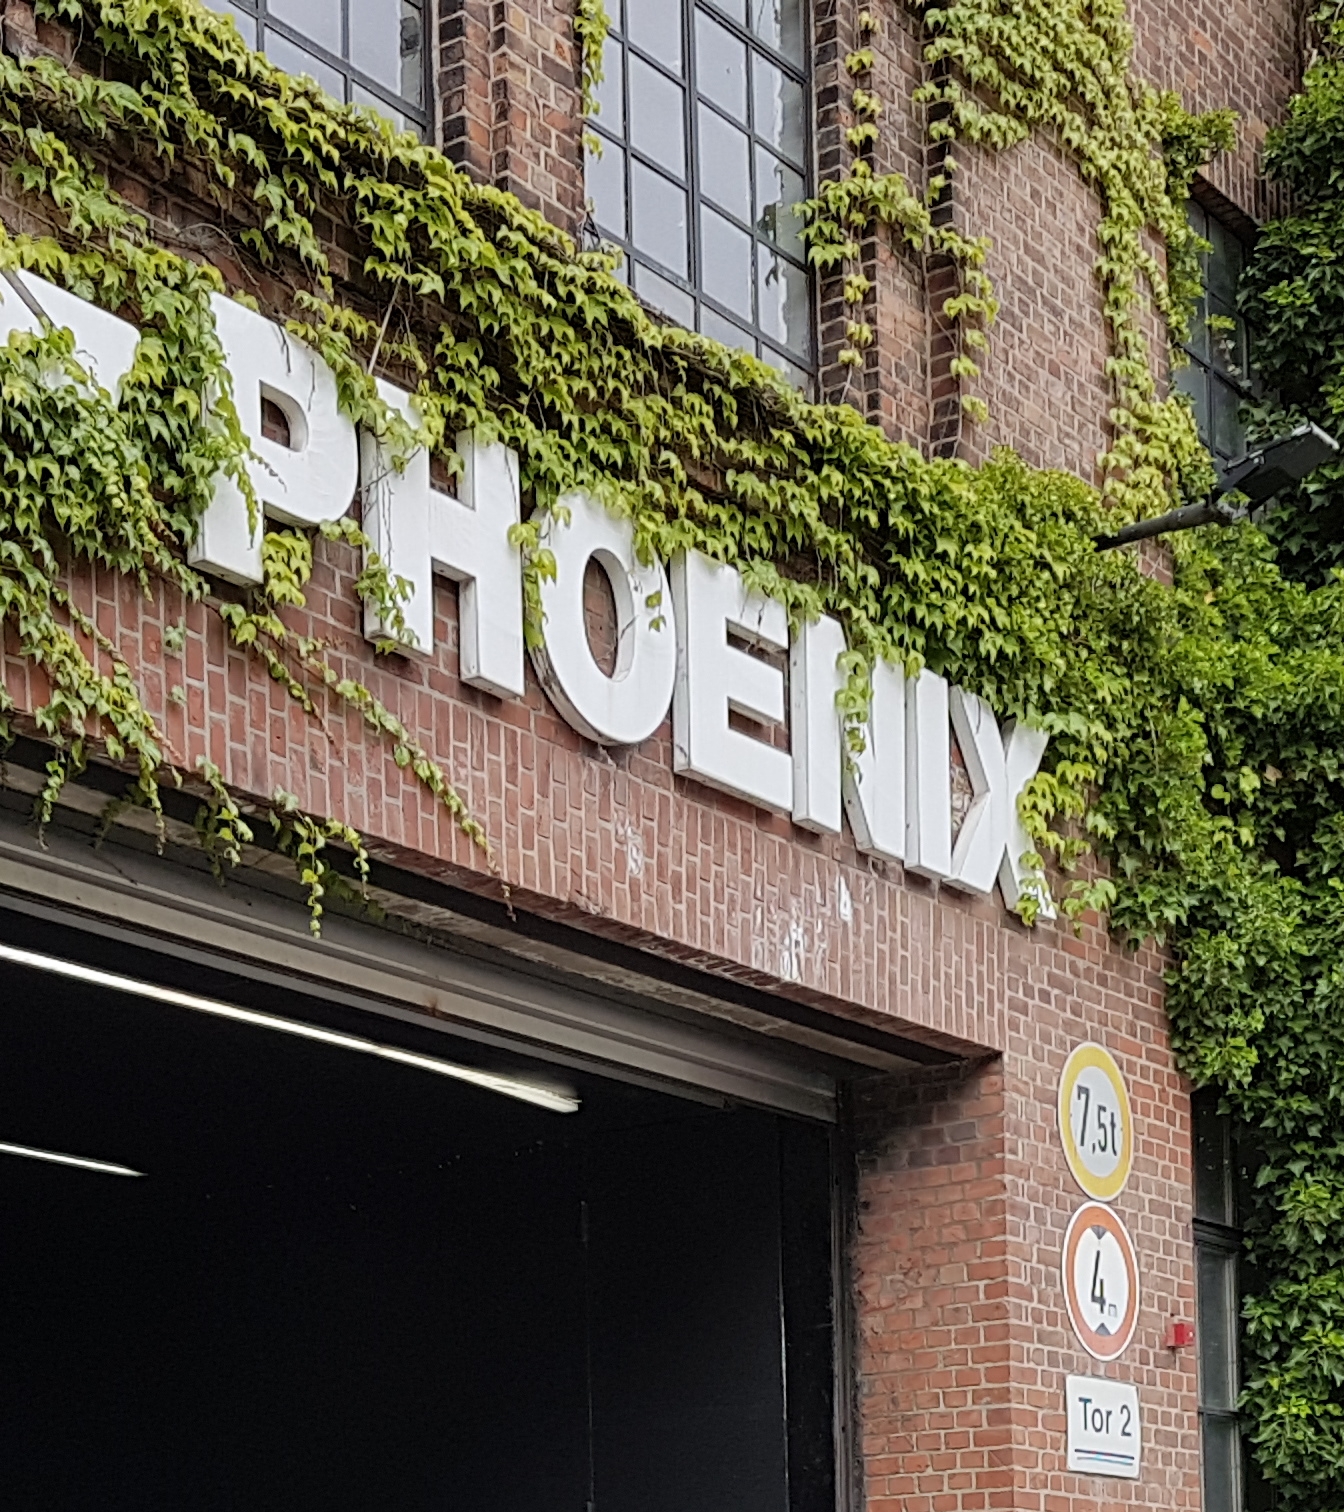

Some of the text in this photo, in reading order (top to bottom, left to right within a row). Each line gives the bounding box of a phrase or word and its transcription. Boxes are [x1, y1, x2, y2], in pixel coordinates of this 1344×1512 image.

[189, 291, 1058, 920] PHOENIX
[1078, 1396, 1132, 1437] Tor 2
